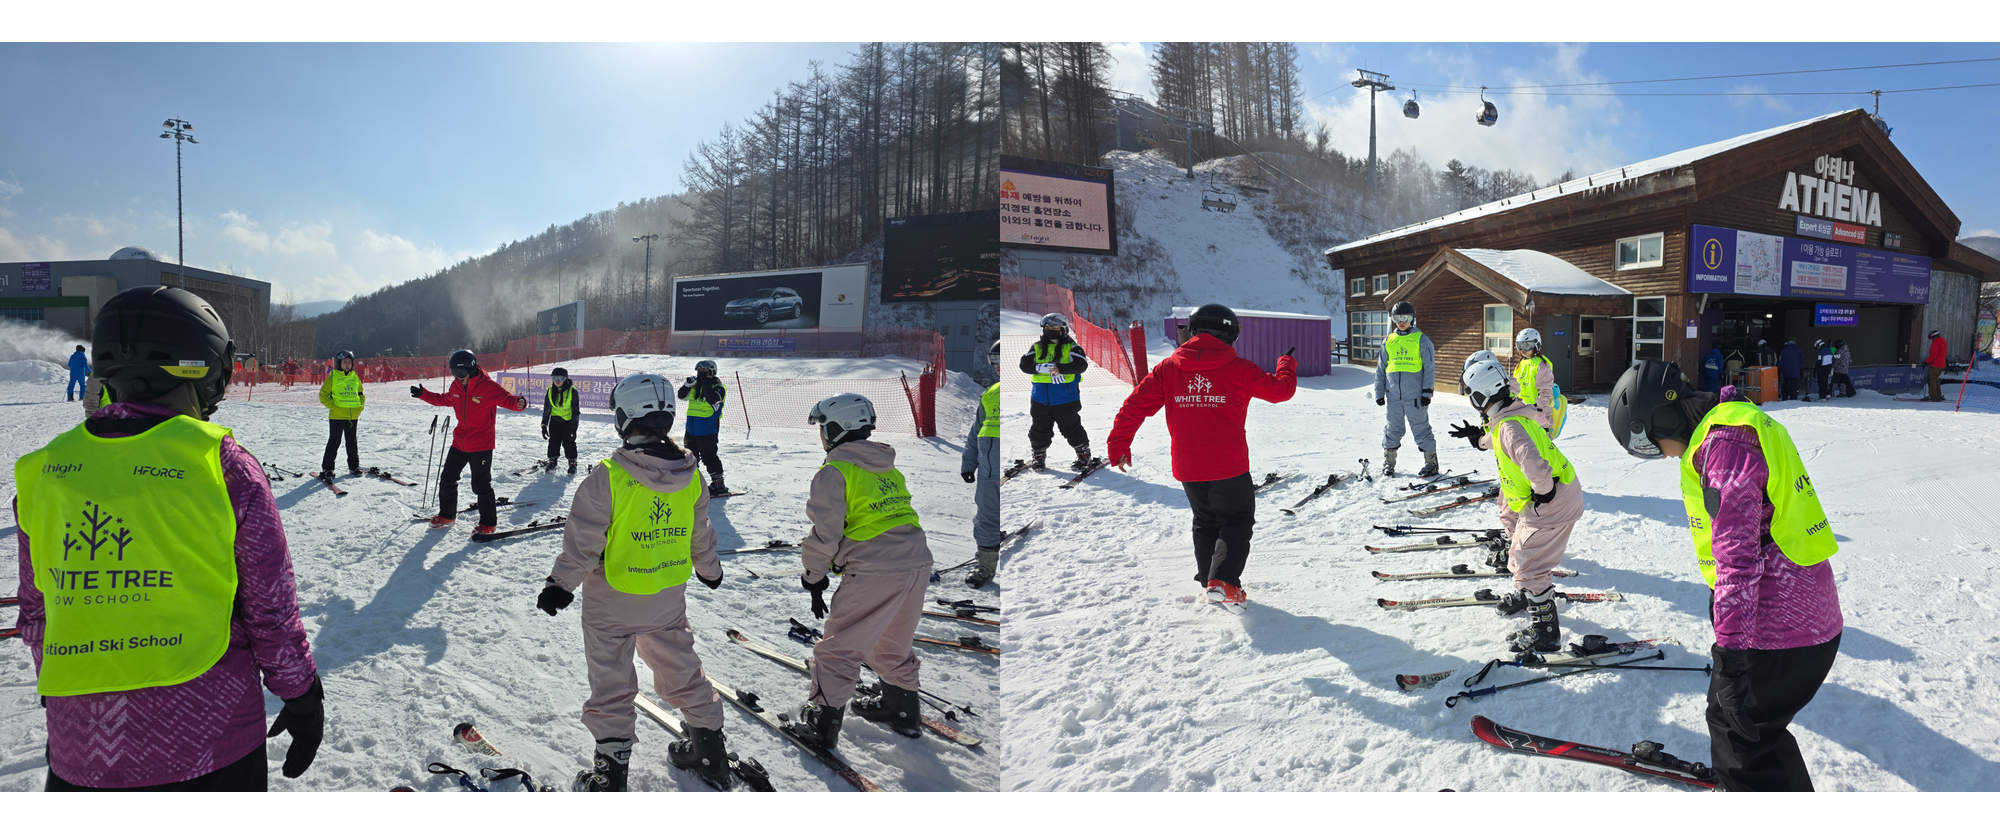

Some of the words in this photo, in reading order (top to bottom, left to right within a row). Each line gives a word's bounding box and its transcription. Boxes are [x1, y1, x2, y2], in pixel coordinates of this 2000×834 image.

[1814, 154, 1855, 186] 아테나
[1777, 171, 1882, 228] ATHENA
[1001, 203, 1030, 214] 지정된
[1034, 206, 1072, 217] 흡연장소
[1001, 215, 1031, 226] 이외의
[1034, 218, 1062, 229] 흡연을
[1065, 221, 1105, 232] 금합니다.
[1800, 220, 1817, 231] Expert
[1695, 274, 1728, 282] INFORMATION
[1174, 395, 1202, 403] WHITE
[1203, 395, 1226, 403] TREE
[48, 464, 83, 473] high1
[133, 465, 185, 479] HFORCE
[662, 527, 687, 537] TREE
[106, 569, 174, 589] TREE
[83, 592, 151, 605] SCHOOL
[99, 638, 124, 652] Ski
[128, 633, 183, 649] School
